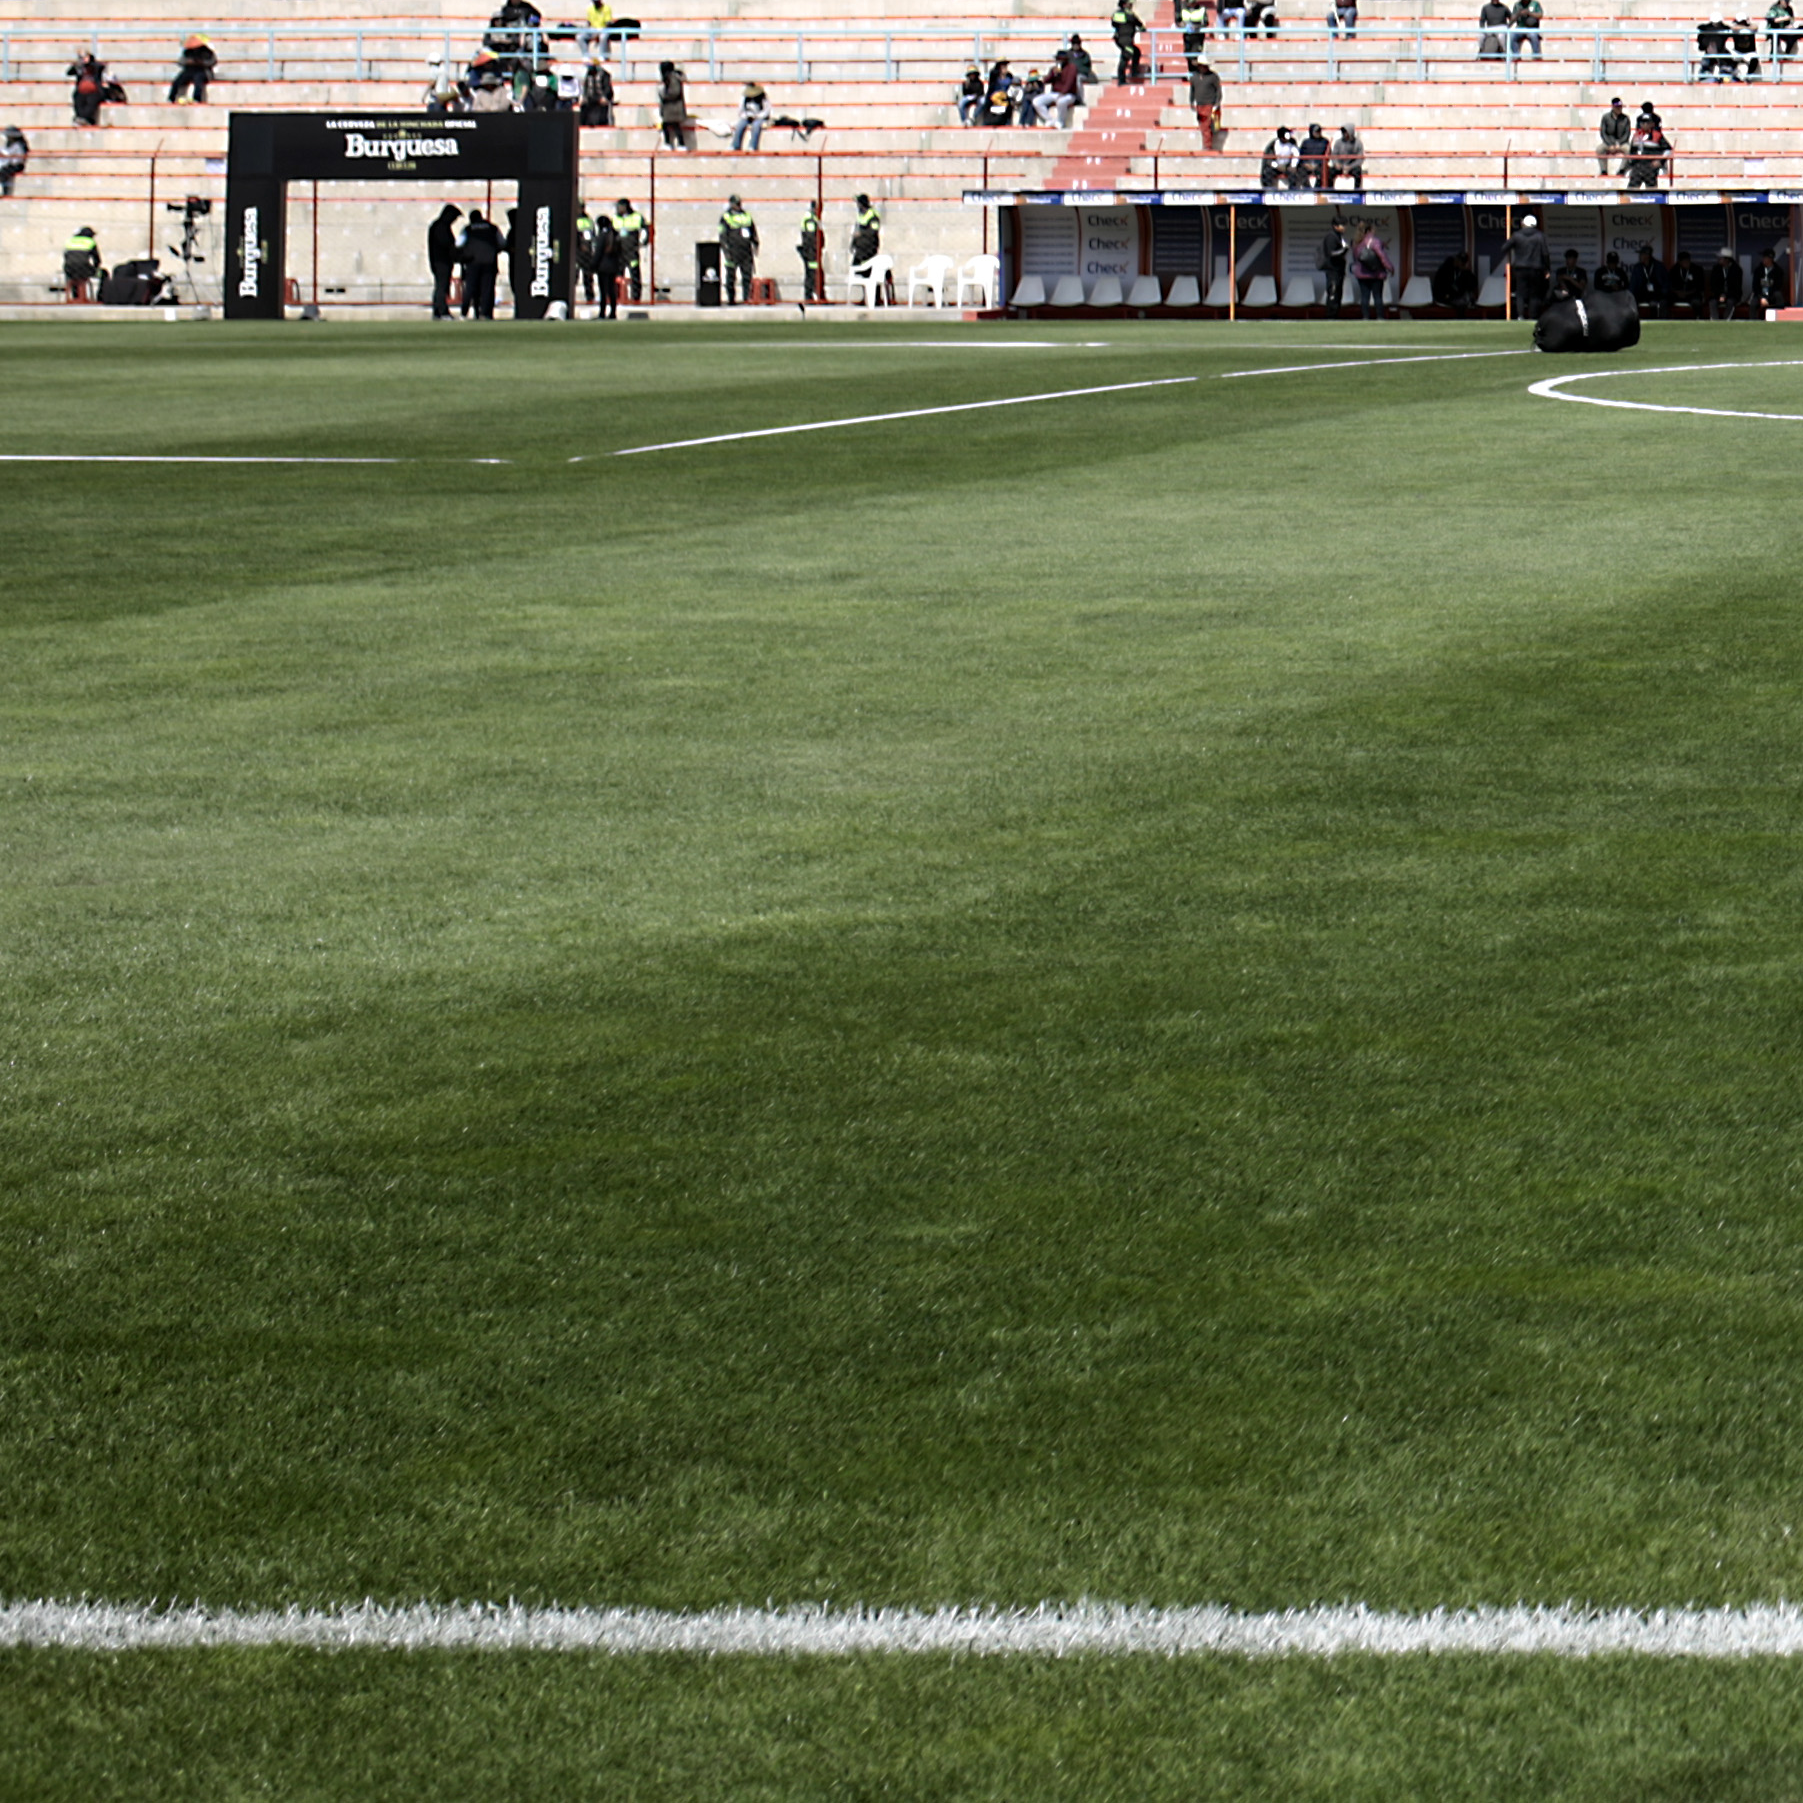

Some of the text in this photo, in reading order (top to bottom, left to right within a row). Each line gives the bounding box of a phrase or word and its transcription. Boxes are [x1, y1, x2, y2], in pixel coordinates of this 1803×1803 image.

[345, 133, 458, 161] Burguesa
[1088, 215, 1129, 227] Check
[1477, 212, 1523, 229] Chec
[1612, 214, 1654, 227] Check
[1089, 237, 1129, 250] Check
[239, 206, 260, 298] Burguesa
[531, 206, 552, 298] Burguesa
[1087, 260, 1129, 274] Check
